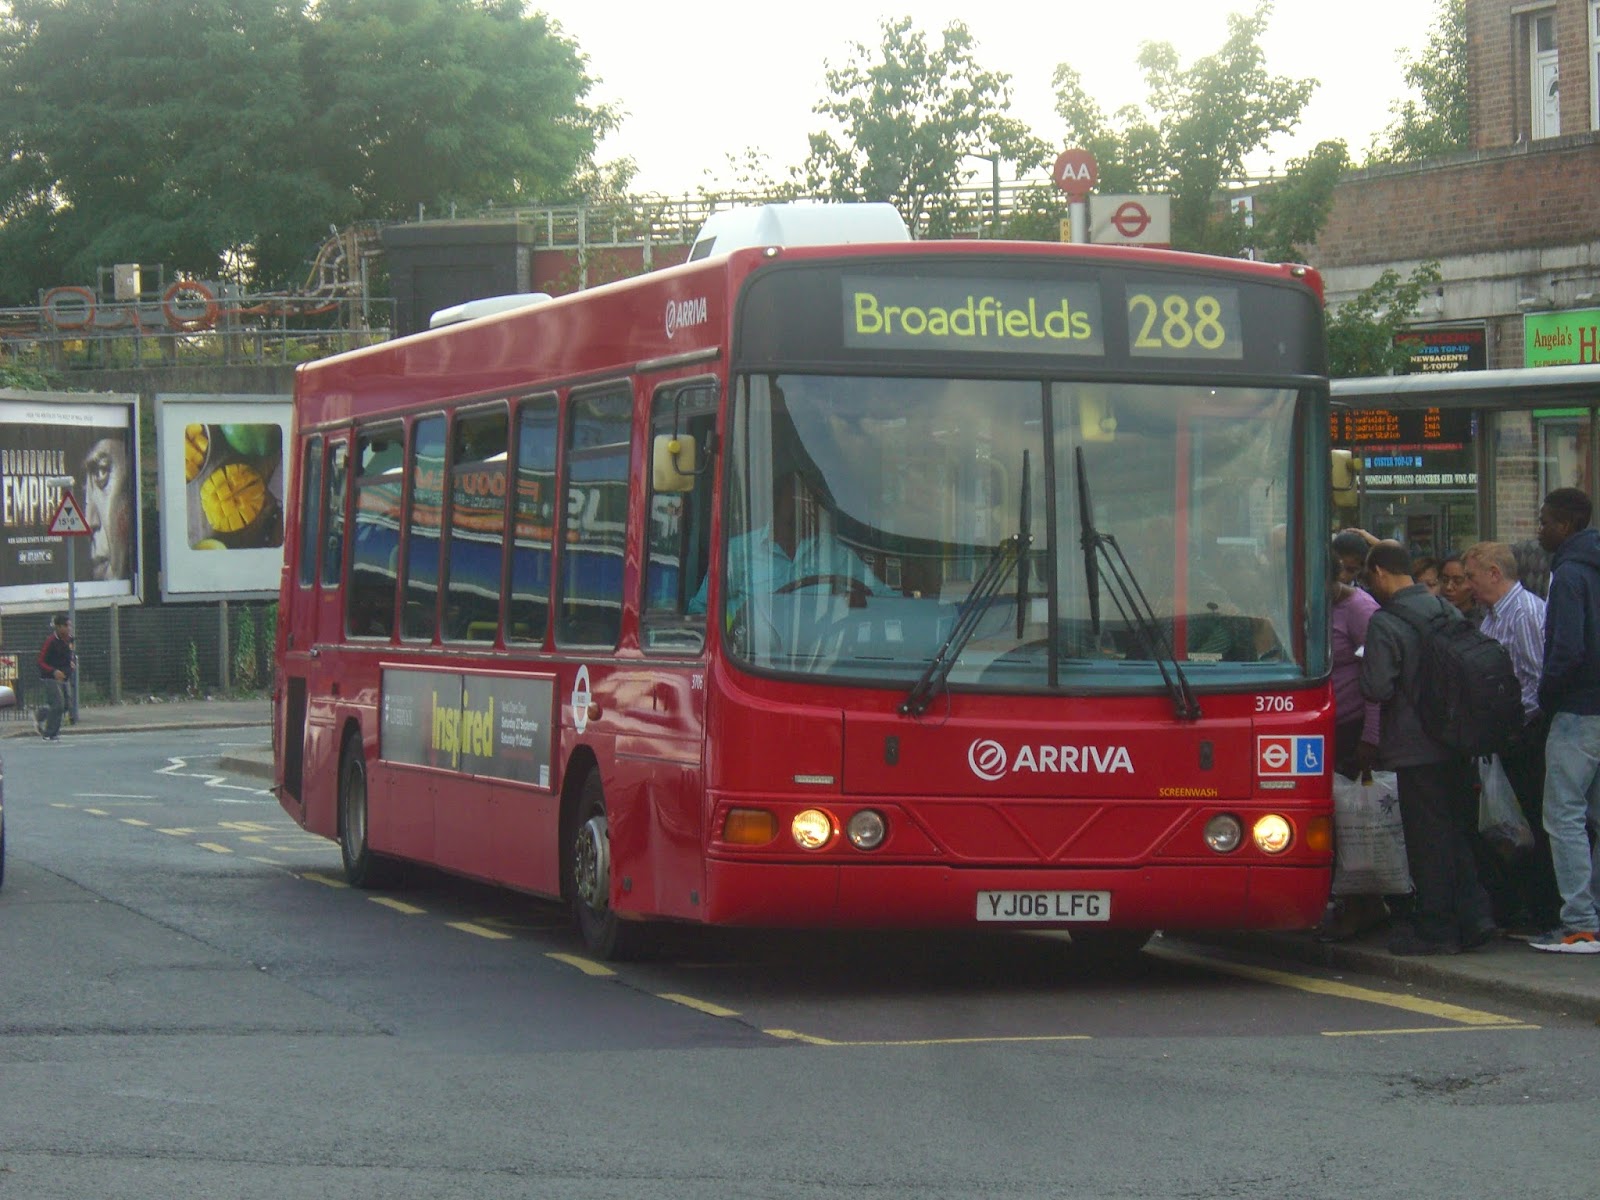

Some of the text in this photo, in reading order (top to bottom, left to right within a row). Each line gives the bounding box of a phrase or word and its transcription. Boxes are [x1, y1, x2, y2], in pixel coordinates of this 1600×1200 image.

[1062, 163, 1091, 180] AA
[676, 296, 708, 328] ARRIVA
[854, 292, 1226, 350] Broadfields 288
[1534, 326, 1600, 364] Angela's H
[1410, 354, 1469, 363] NEWSAGENTS
[2, 450, 66, 475] BOARDWALK
[1374, 457, 1413, 468] OYSTER TOP-UP
[1393, 475, 1414, 485] TOBACCO
[1415, 474, 1440, 485] GROCERIES
[1255, 696, 1294, 712] 3706
[432, 690, 494, 768] Inspired
[1012, 745, 1135, 774] ARRIVA
[1159, 787, 1218, 798] SCREENWASH
[988, 894, 1101, 917] YJ06 LFG
